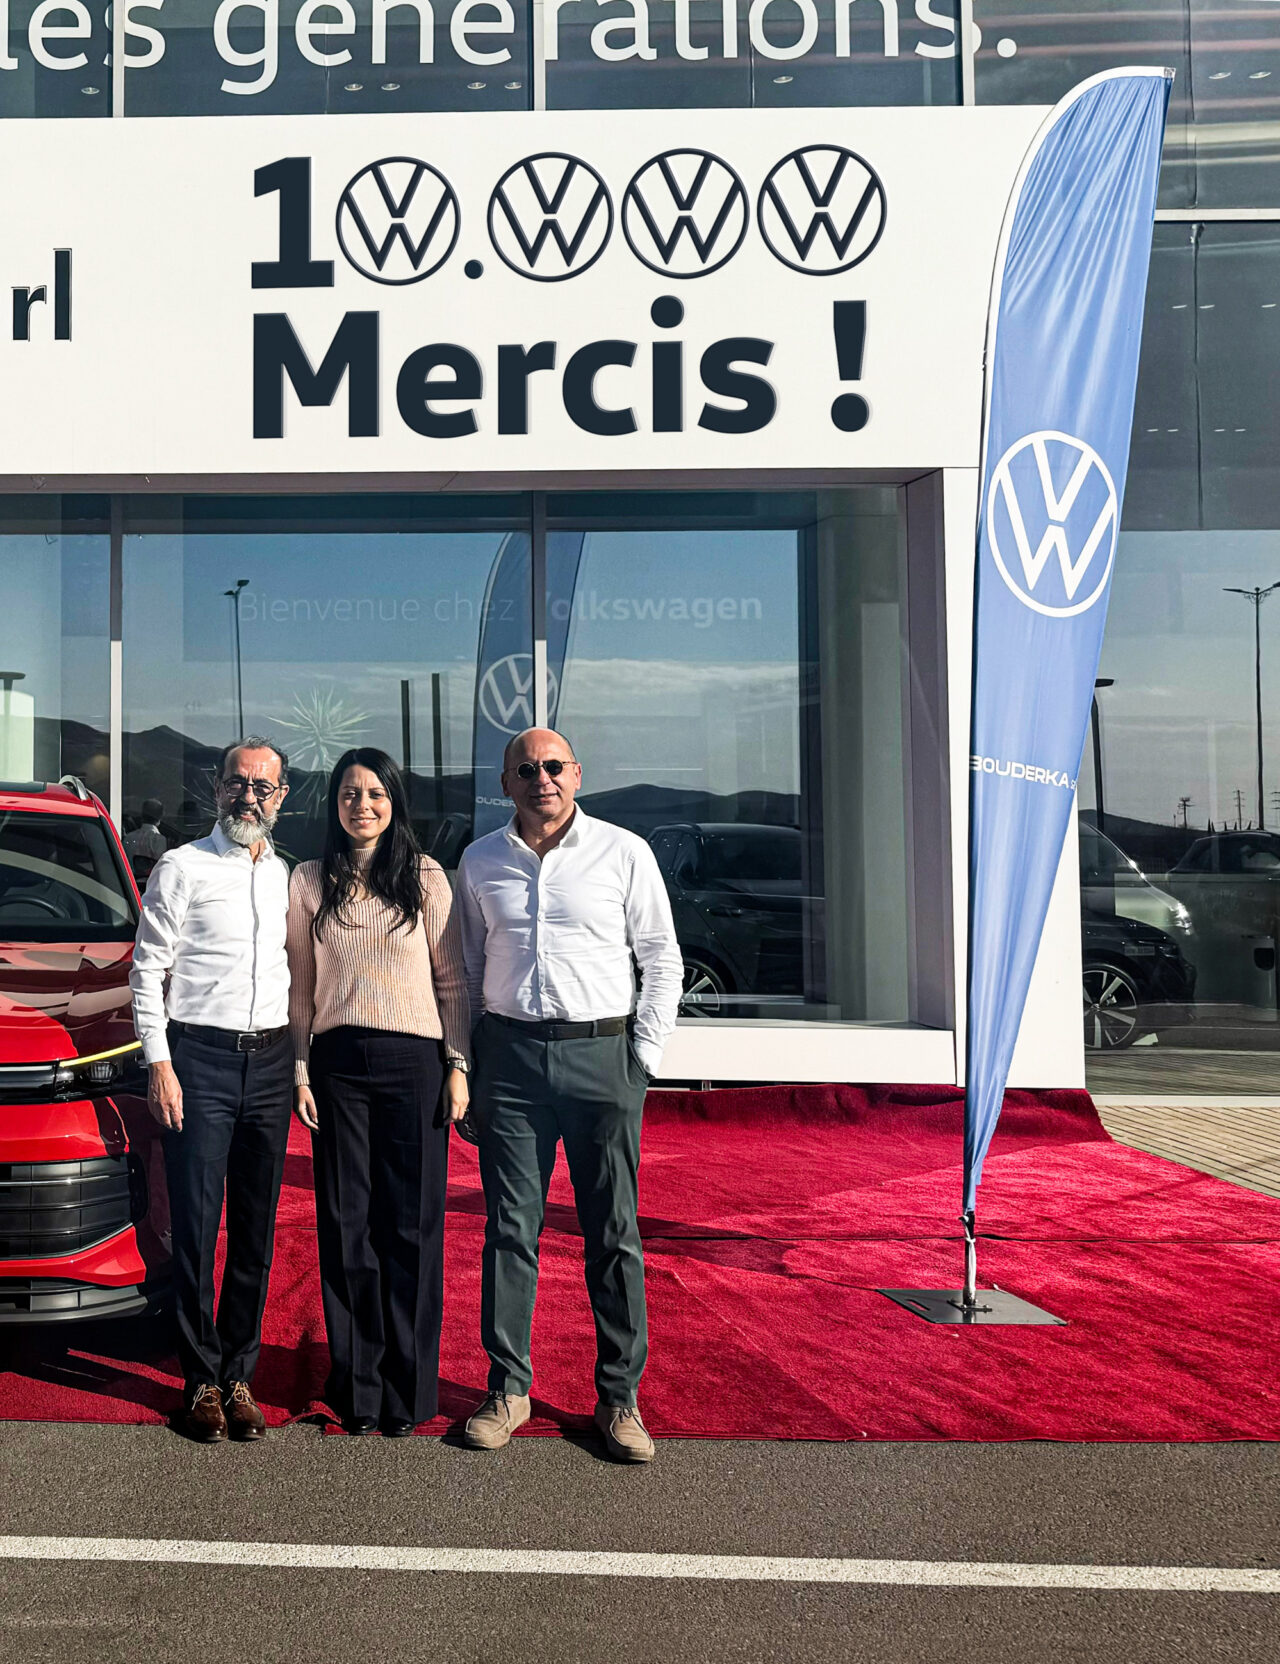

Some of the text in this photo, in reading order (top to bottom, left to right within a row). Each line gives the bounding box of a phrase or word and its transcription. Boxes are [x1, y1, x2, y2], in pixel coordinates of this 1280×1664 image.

[252, 296, 870, 441] Mercis !
[237, 590, 764, 628] Bienvenue chez olkswagen
